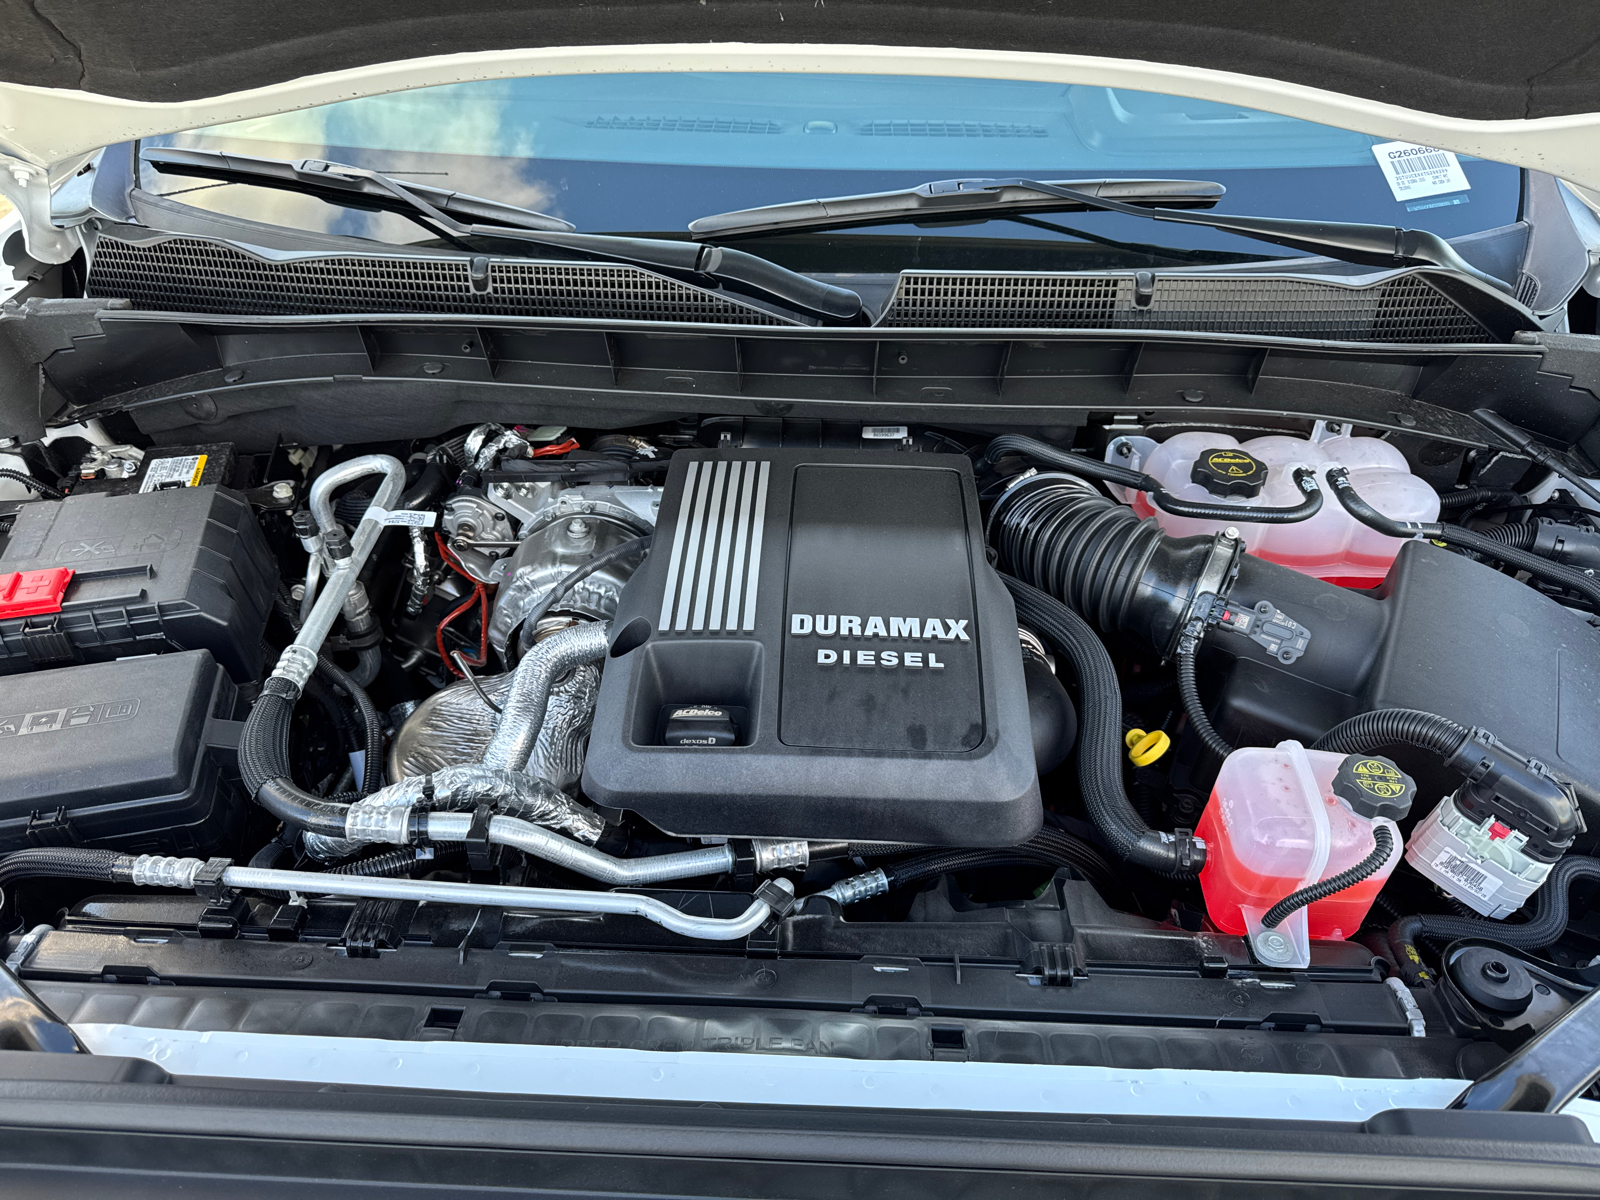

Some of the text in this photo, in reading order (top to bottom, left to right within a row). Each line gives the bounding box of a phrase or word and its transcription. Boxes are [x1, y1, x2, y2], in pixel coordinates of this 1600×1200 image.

[791, 613, 971, 641] DURAMAX
[817, 649, 945, 669] DIESEL
[671, 708, 723, 718] ACDelco
